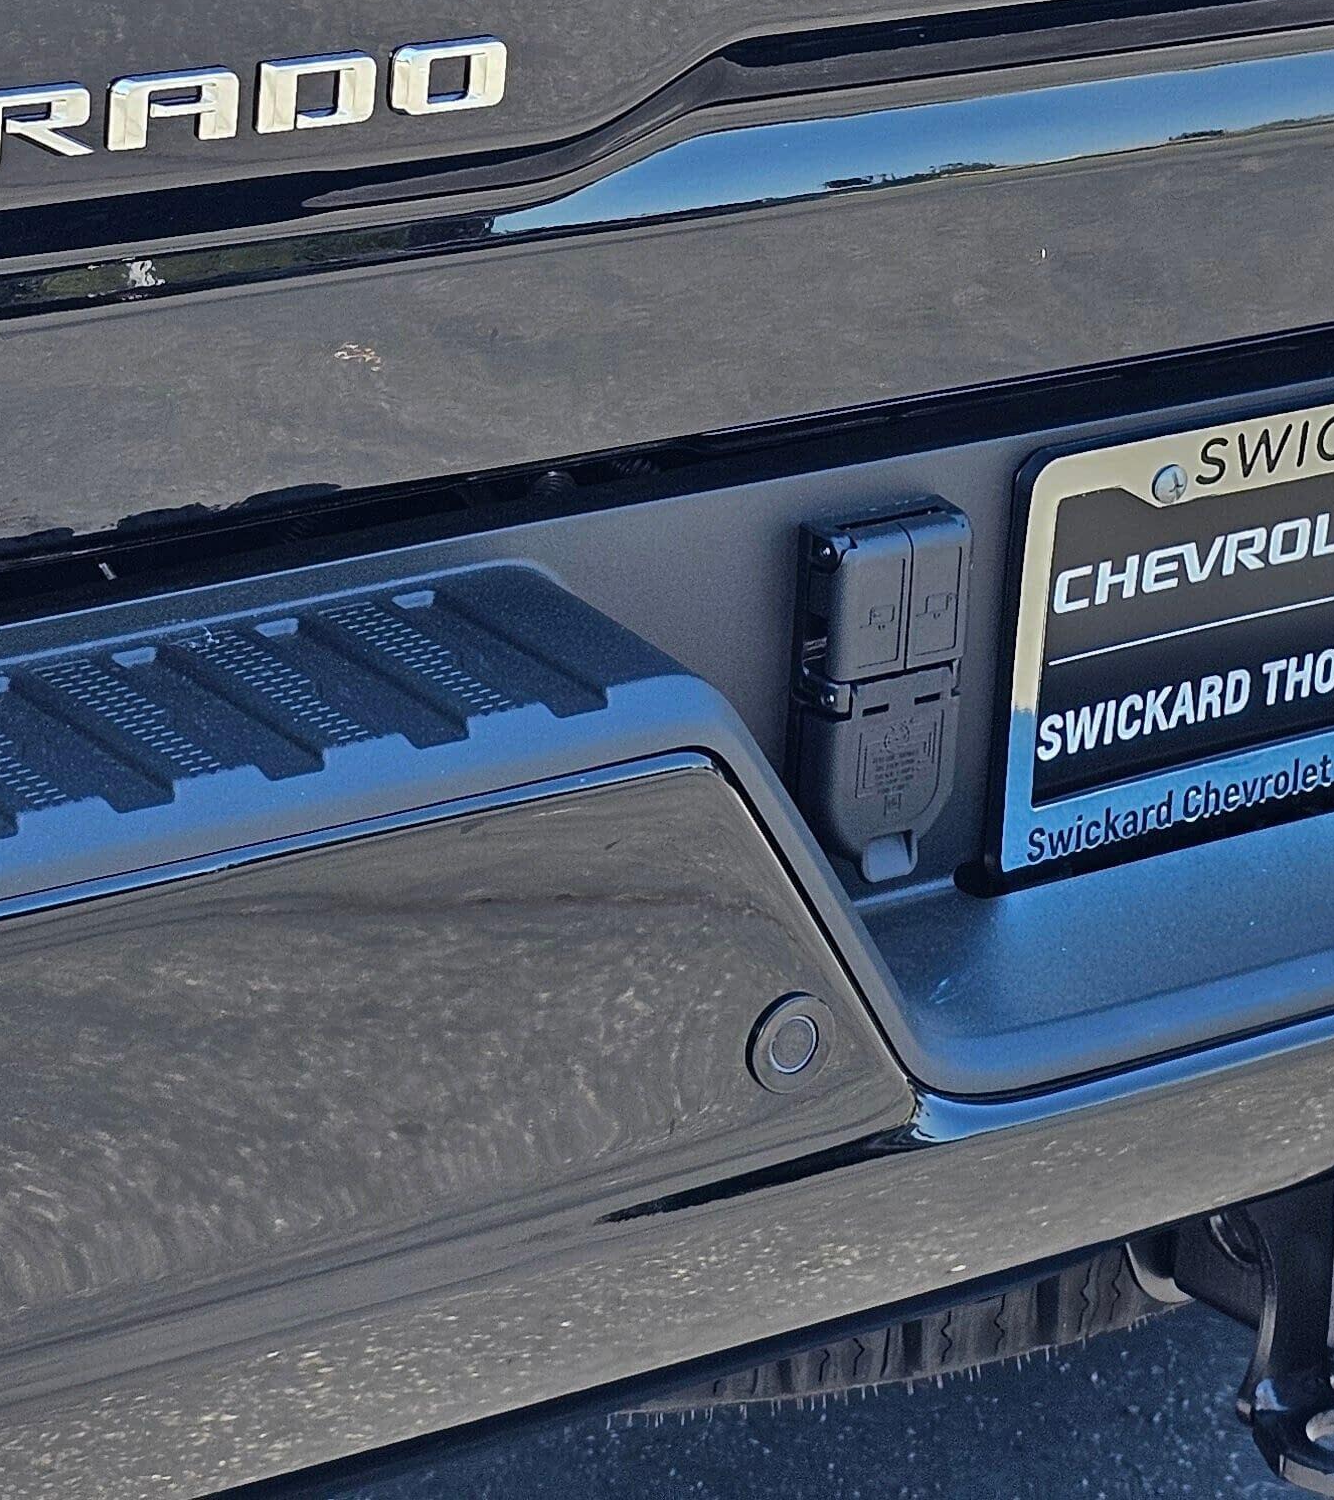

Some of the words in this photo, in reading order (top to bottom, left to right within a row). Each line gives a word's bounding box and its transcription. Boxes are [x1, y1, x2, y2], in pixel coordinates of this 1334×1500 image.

[1036, 668, 1251, 762] SWICKARD
[1026, 789, 1173, 863] Swickard
[1181, 754, 1332, 823] Chevrolet
